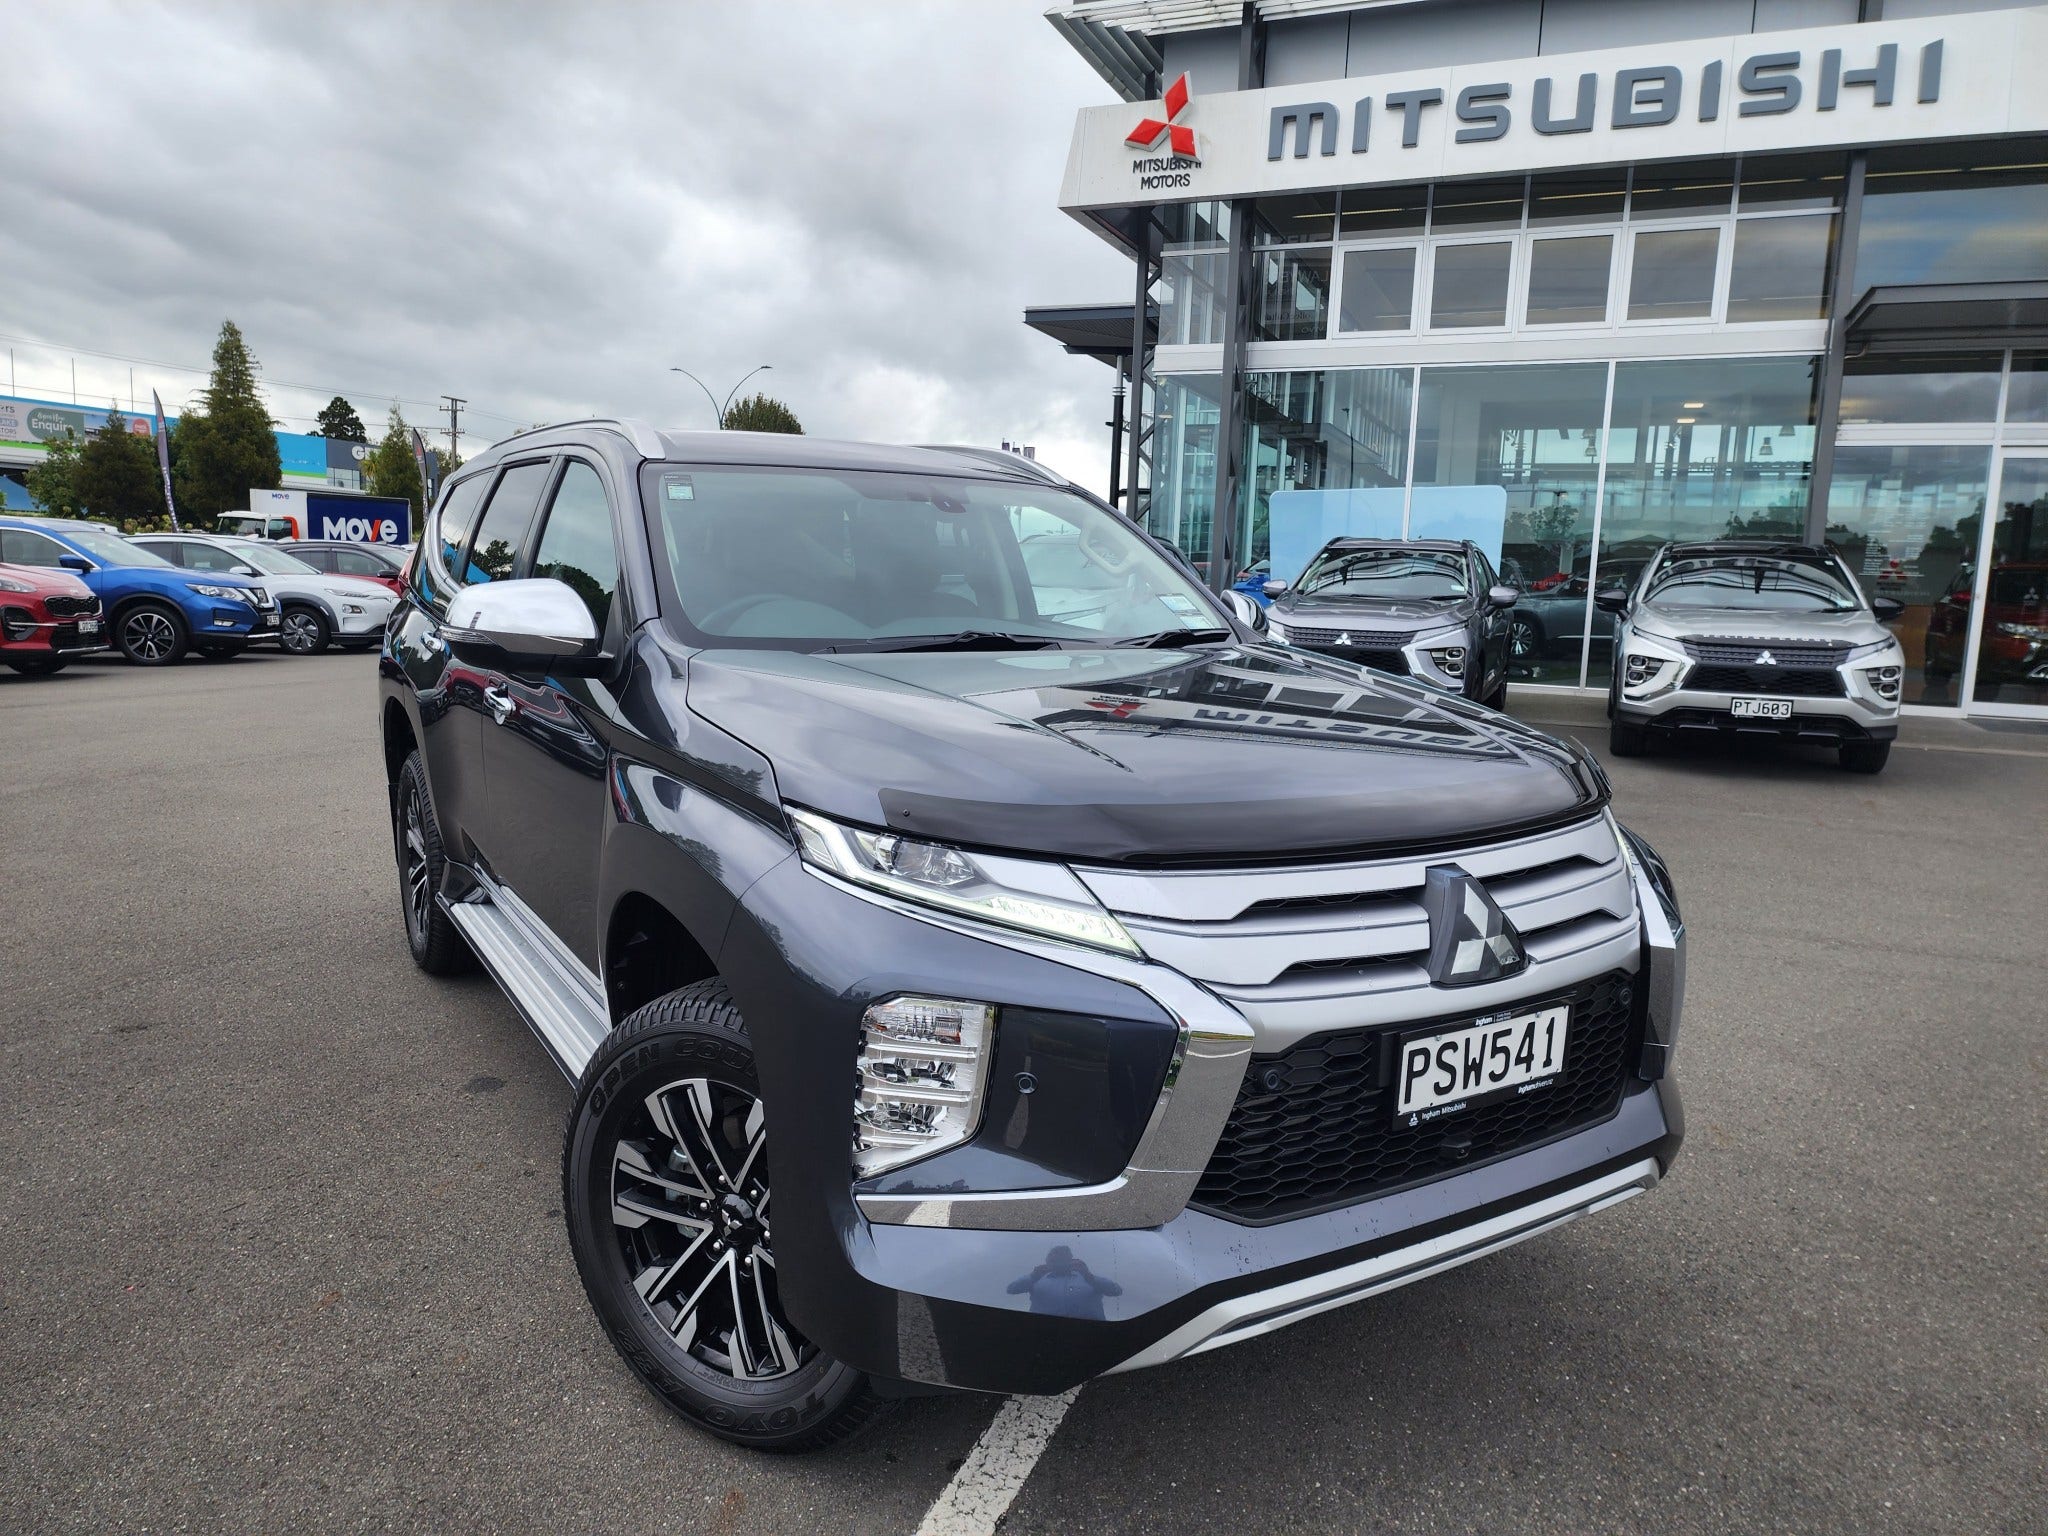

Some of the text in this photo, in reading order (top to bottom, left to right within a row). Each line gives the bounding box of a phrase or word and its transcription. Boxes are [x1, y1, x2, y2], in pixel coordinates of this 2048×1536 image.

[1268, 38, 1944, 162] MITSUBISHI
[1140, 173, 1191, 190] MOTORS
[1733, 701, 1790, 716] PTJ603
[590, 1043, 661, 1118] OPEN
[1404, 1016, 1556, 1105] PSW541
[1421, 1101, 1467, 1121] Ingham Mitsubishi
[702, 1392, 825, 1432] TOYO
